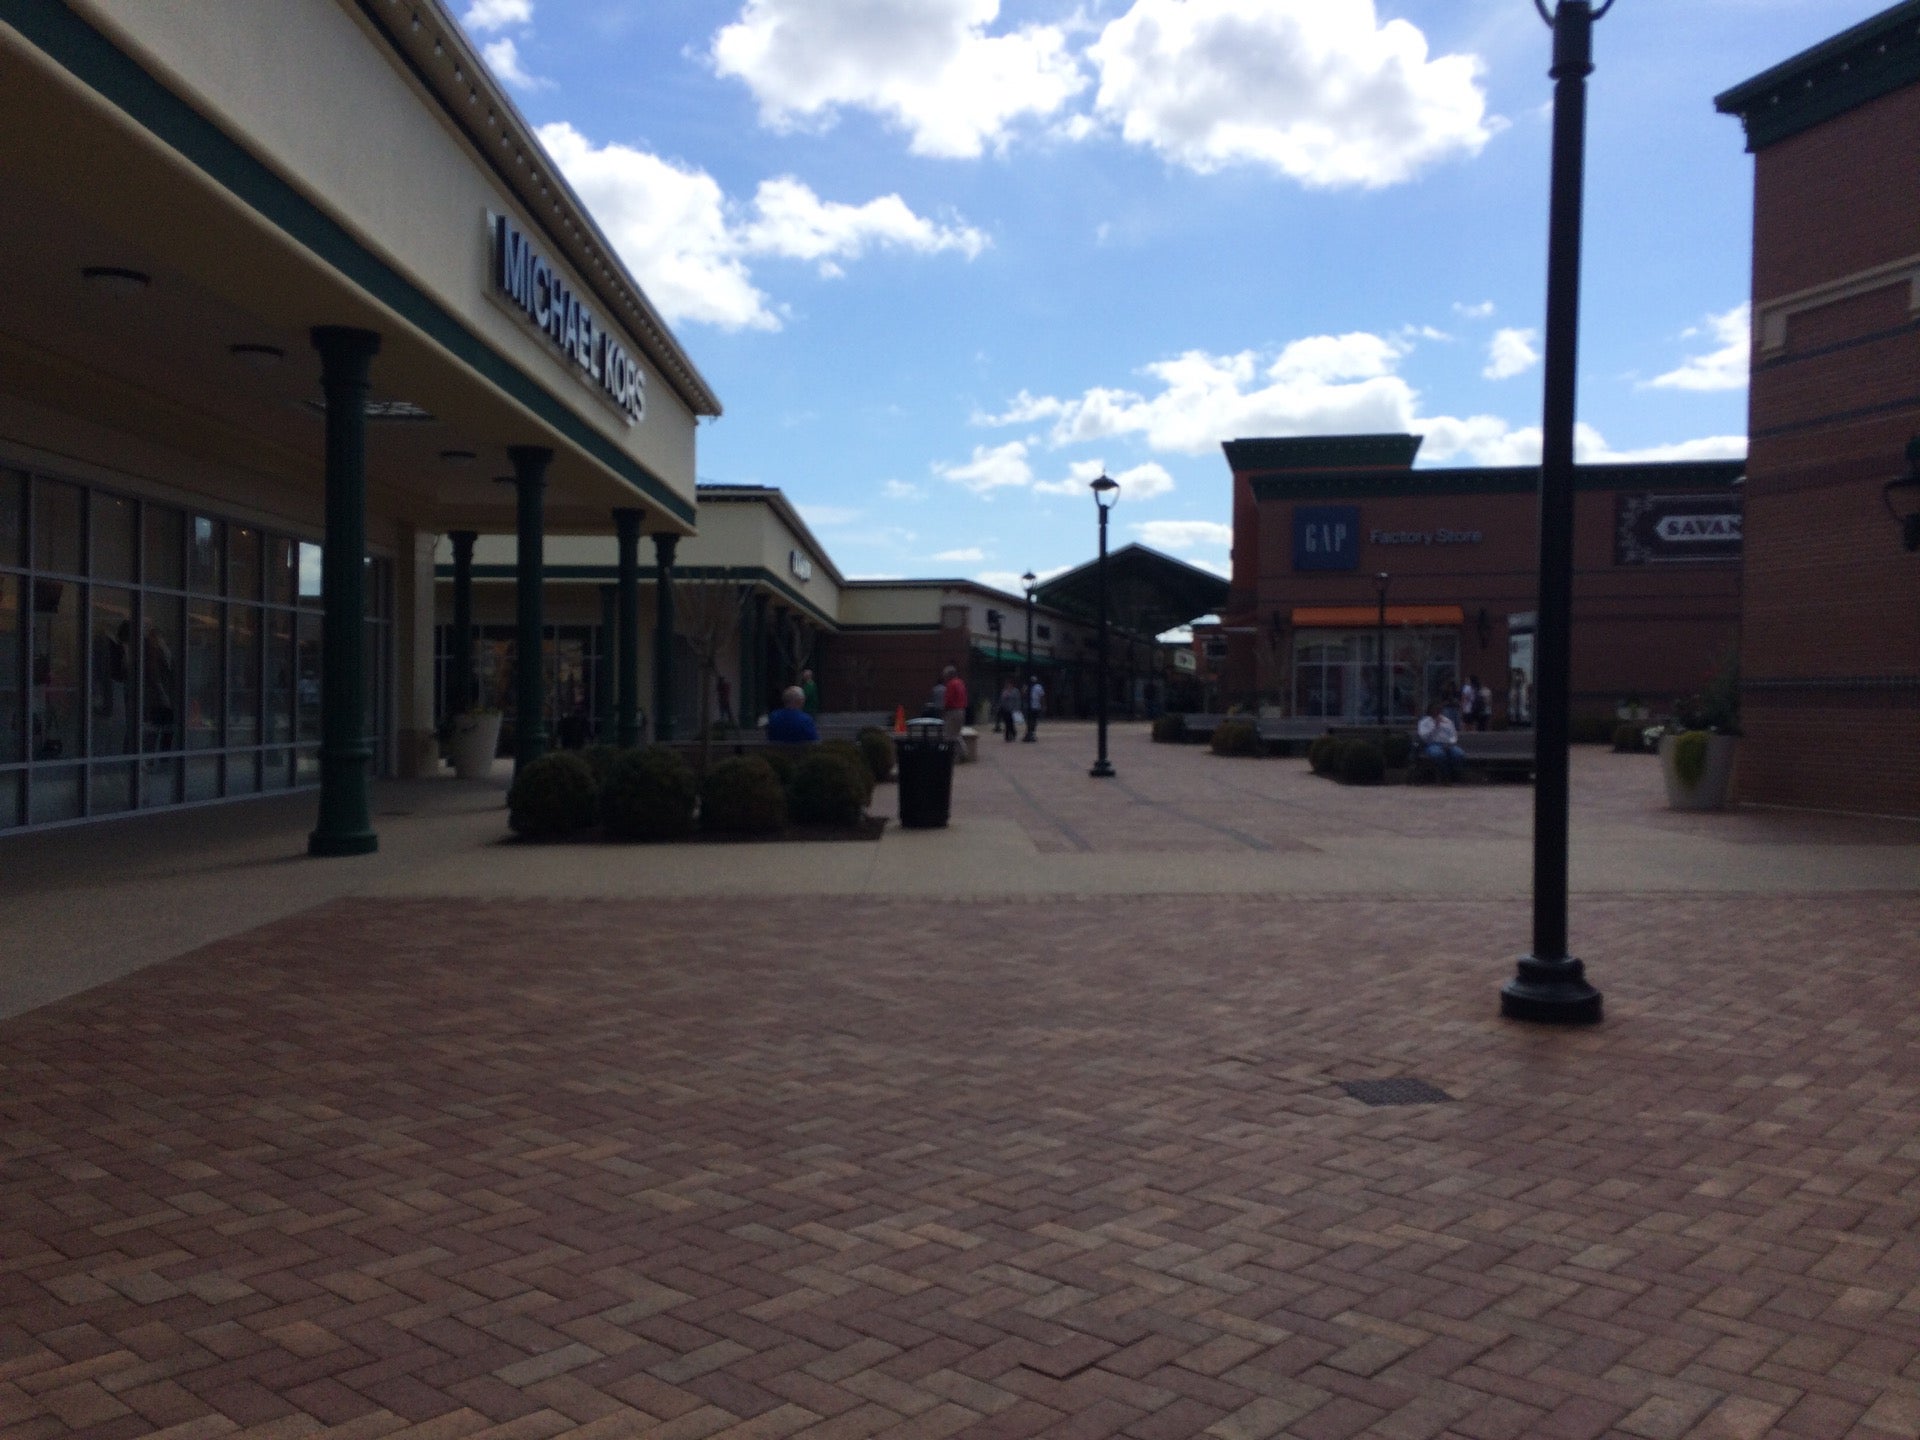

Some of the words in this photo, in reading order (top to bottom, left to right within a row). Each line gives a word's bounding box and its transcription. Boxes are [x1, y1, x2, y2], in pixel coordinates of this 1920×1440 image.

[501, 214, 601, 379] MICHAEL
[603, 335, 646, 423] KORS
[1305, 523, 1347, 552] GAP
[1370, 529, 1432, 546] Factory
[1435, 527, 1482, 543] Store
